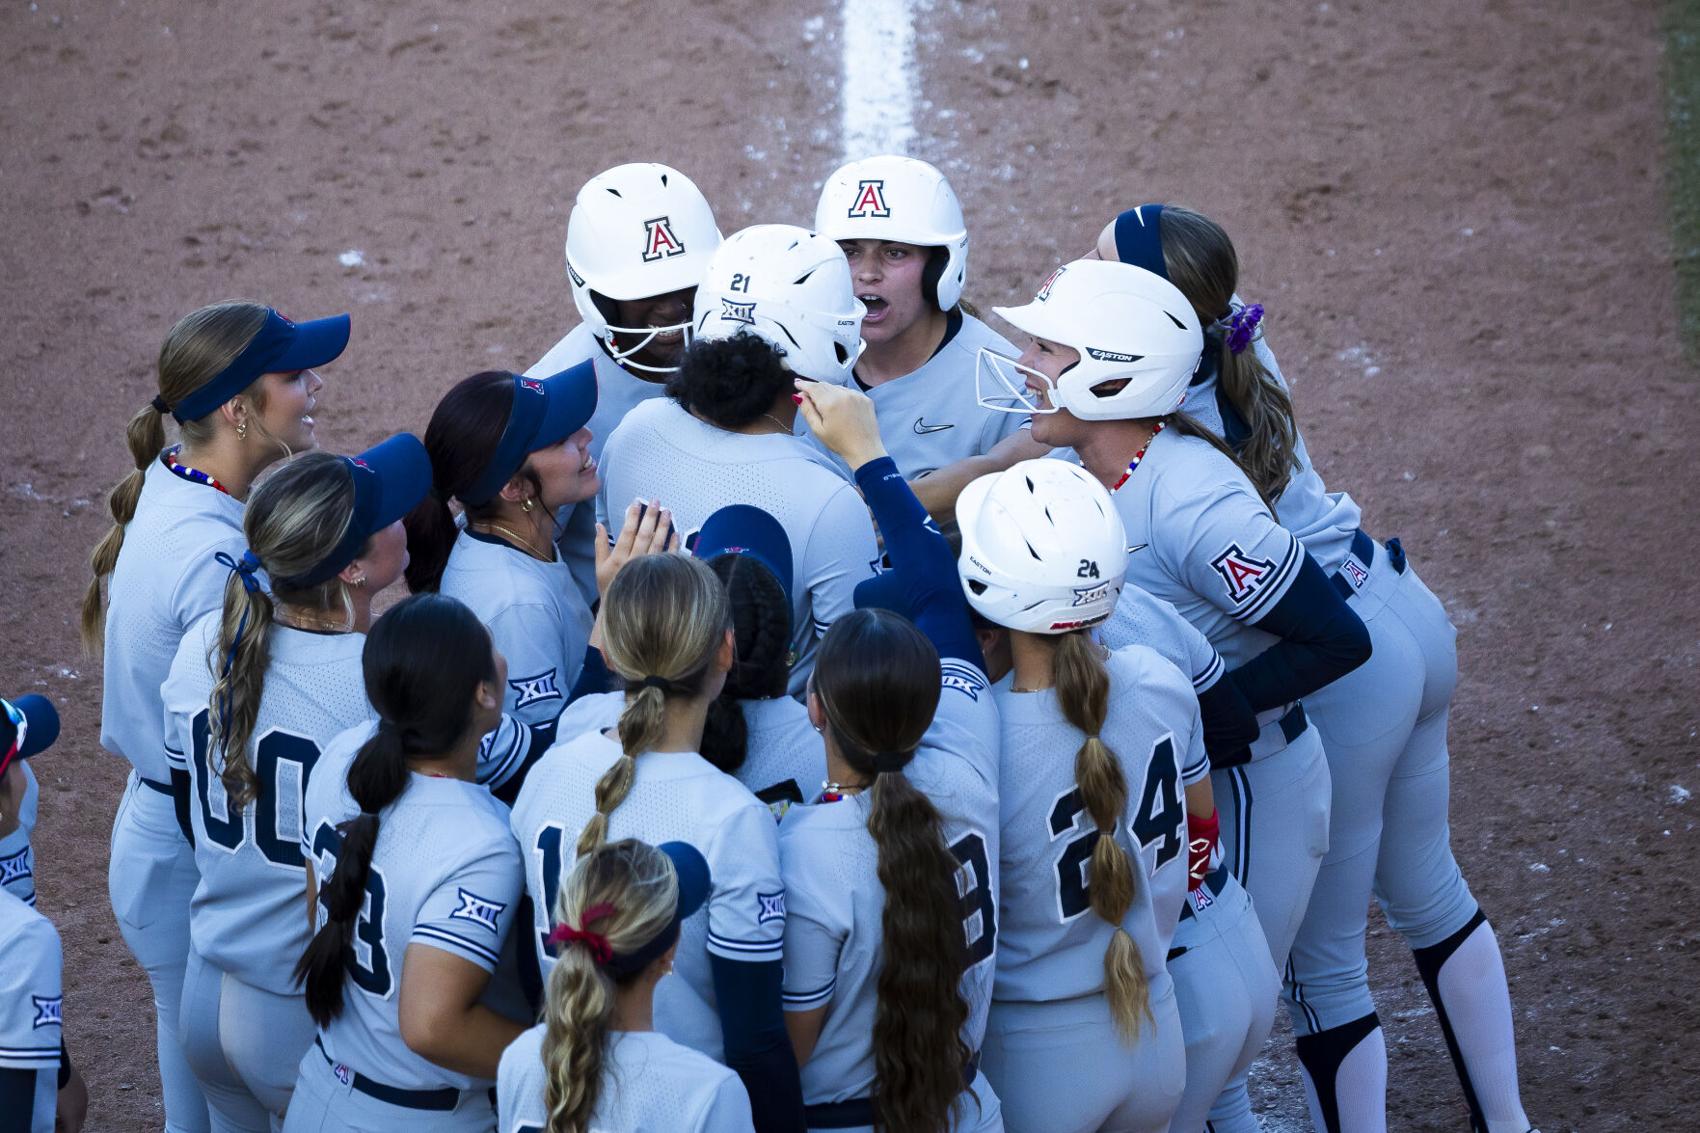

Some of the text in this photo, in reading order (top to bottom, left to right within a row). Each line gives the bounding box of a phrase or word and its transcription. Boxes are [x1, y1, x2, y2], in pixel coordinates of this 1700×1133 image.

[847, 180, 891, 218] A
[642, 216, 685, 262] A
[730, 273, 751, 293] 21
[721, 297, 757, 325] XII
[1091, 350, 1133, 362] EASTON
[969, 556, 992, 576] EASTON
[1077, 559, 1100, 579] 24
[1210, 543, 1277, 605] A
[1343, 559, 1368, 589] A
[508, 667, 562, 710] XII
[189, 704, 322, 872] 00
[1045, 731, 1188, 925] 24
[0, 845, 33, 886] XII
[449, 887, 507, 935] XII
[1193, 887, 1213, 912] A
